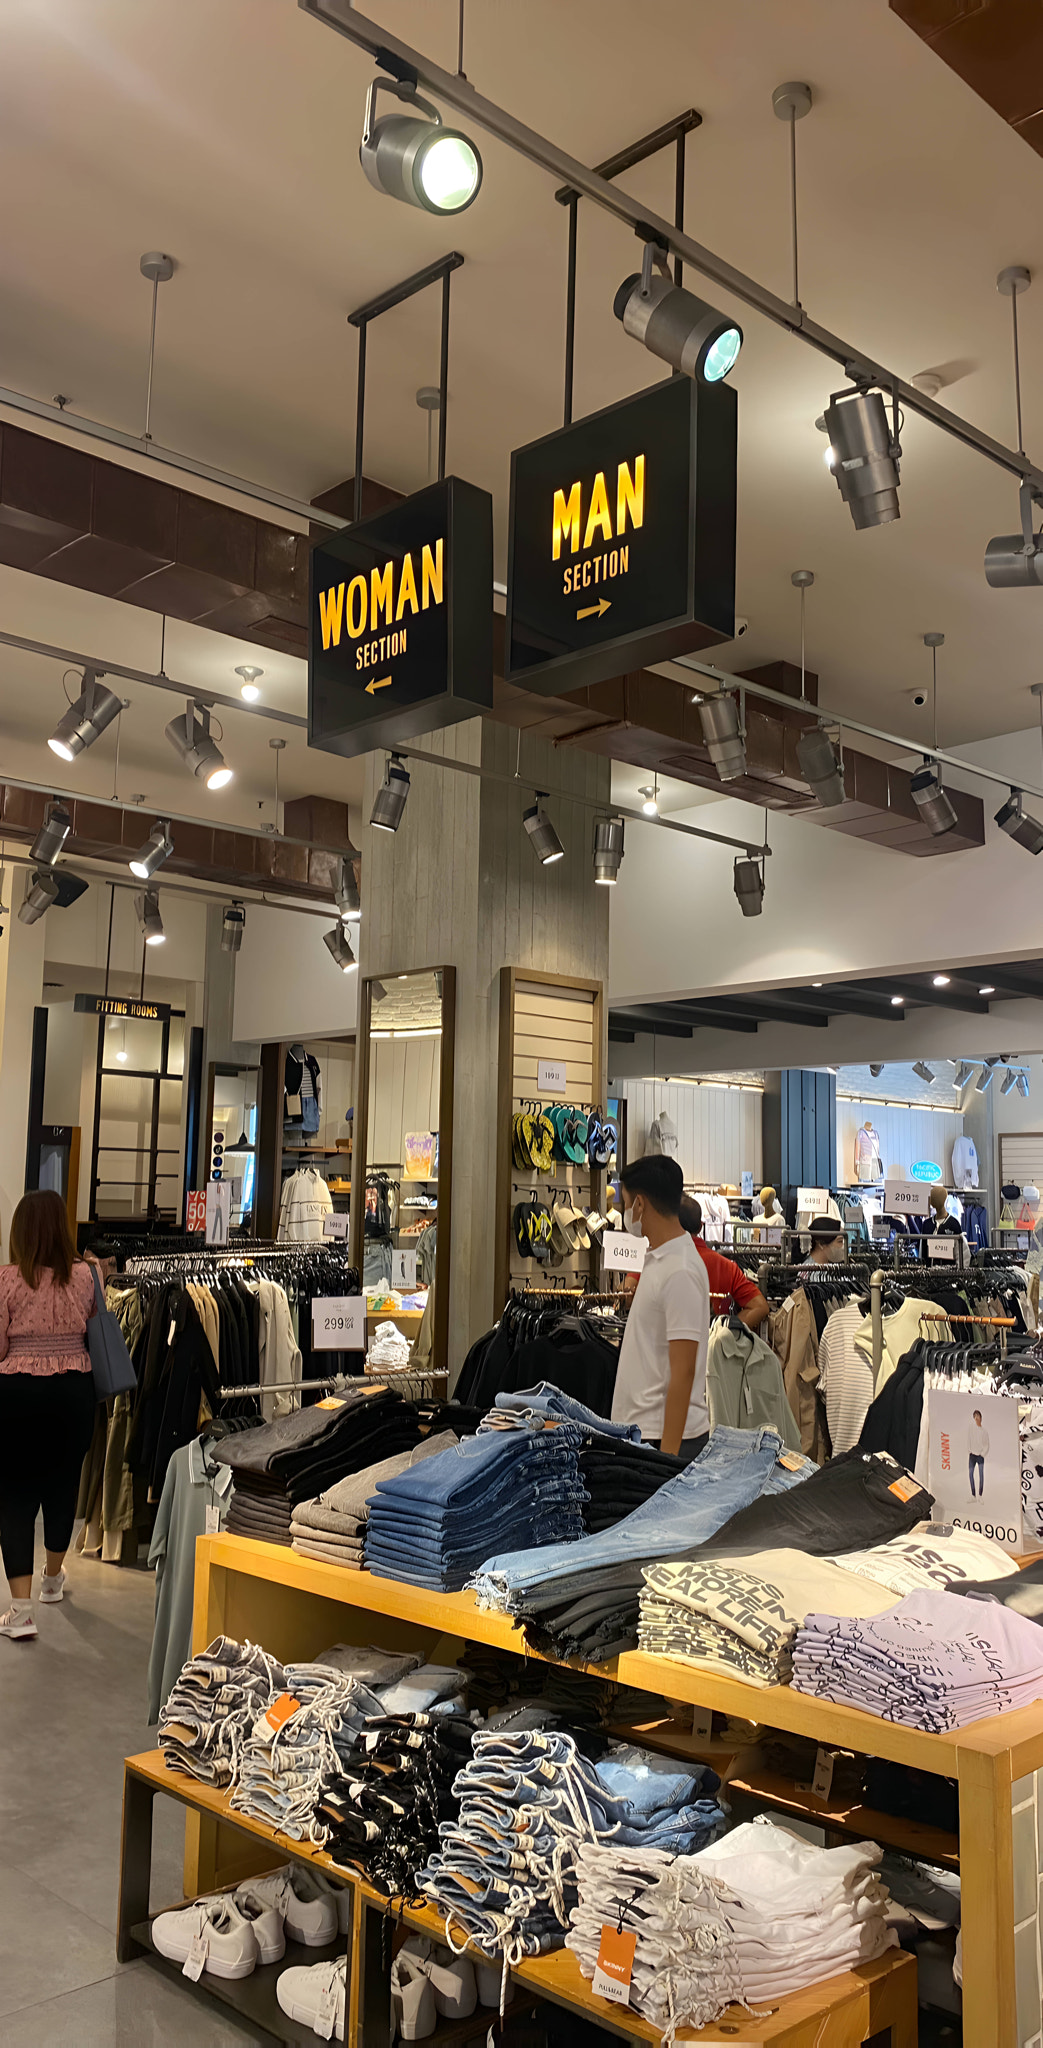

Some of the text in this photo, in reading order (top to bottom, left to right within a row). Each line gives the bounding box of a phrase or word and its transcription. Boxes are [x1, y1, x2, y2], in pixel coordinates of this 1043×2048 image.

[552, 454, 645, 561] MAN
[563, 545, 629, 595] SECTION
[318, 538, 444, 650] WOMAN
[356, 629, 407, 671] SECTION
[96, 1000, 158, 1018] FITTING ROOMS
[188, 1202, 206, 1220] 50
[941, 1431, 951, 1470] SKINNY
[678, 1564, 764, 1614] MORE
